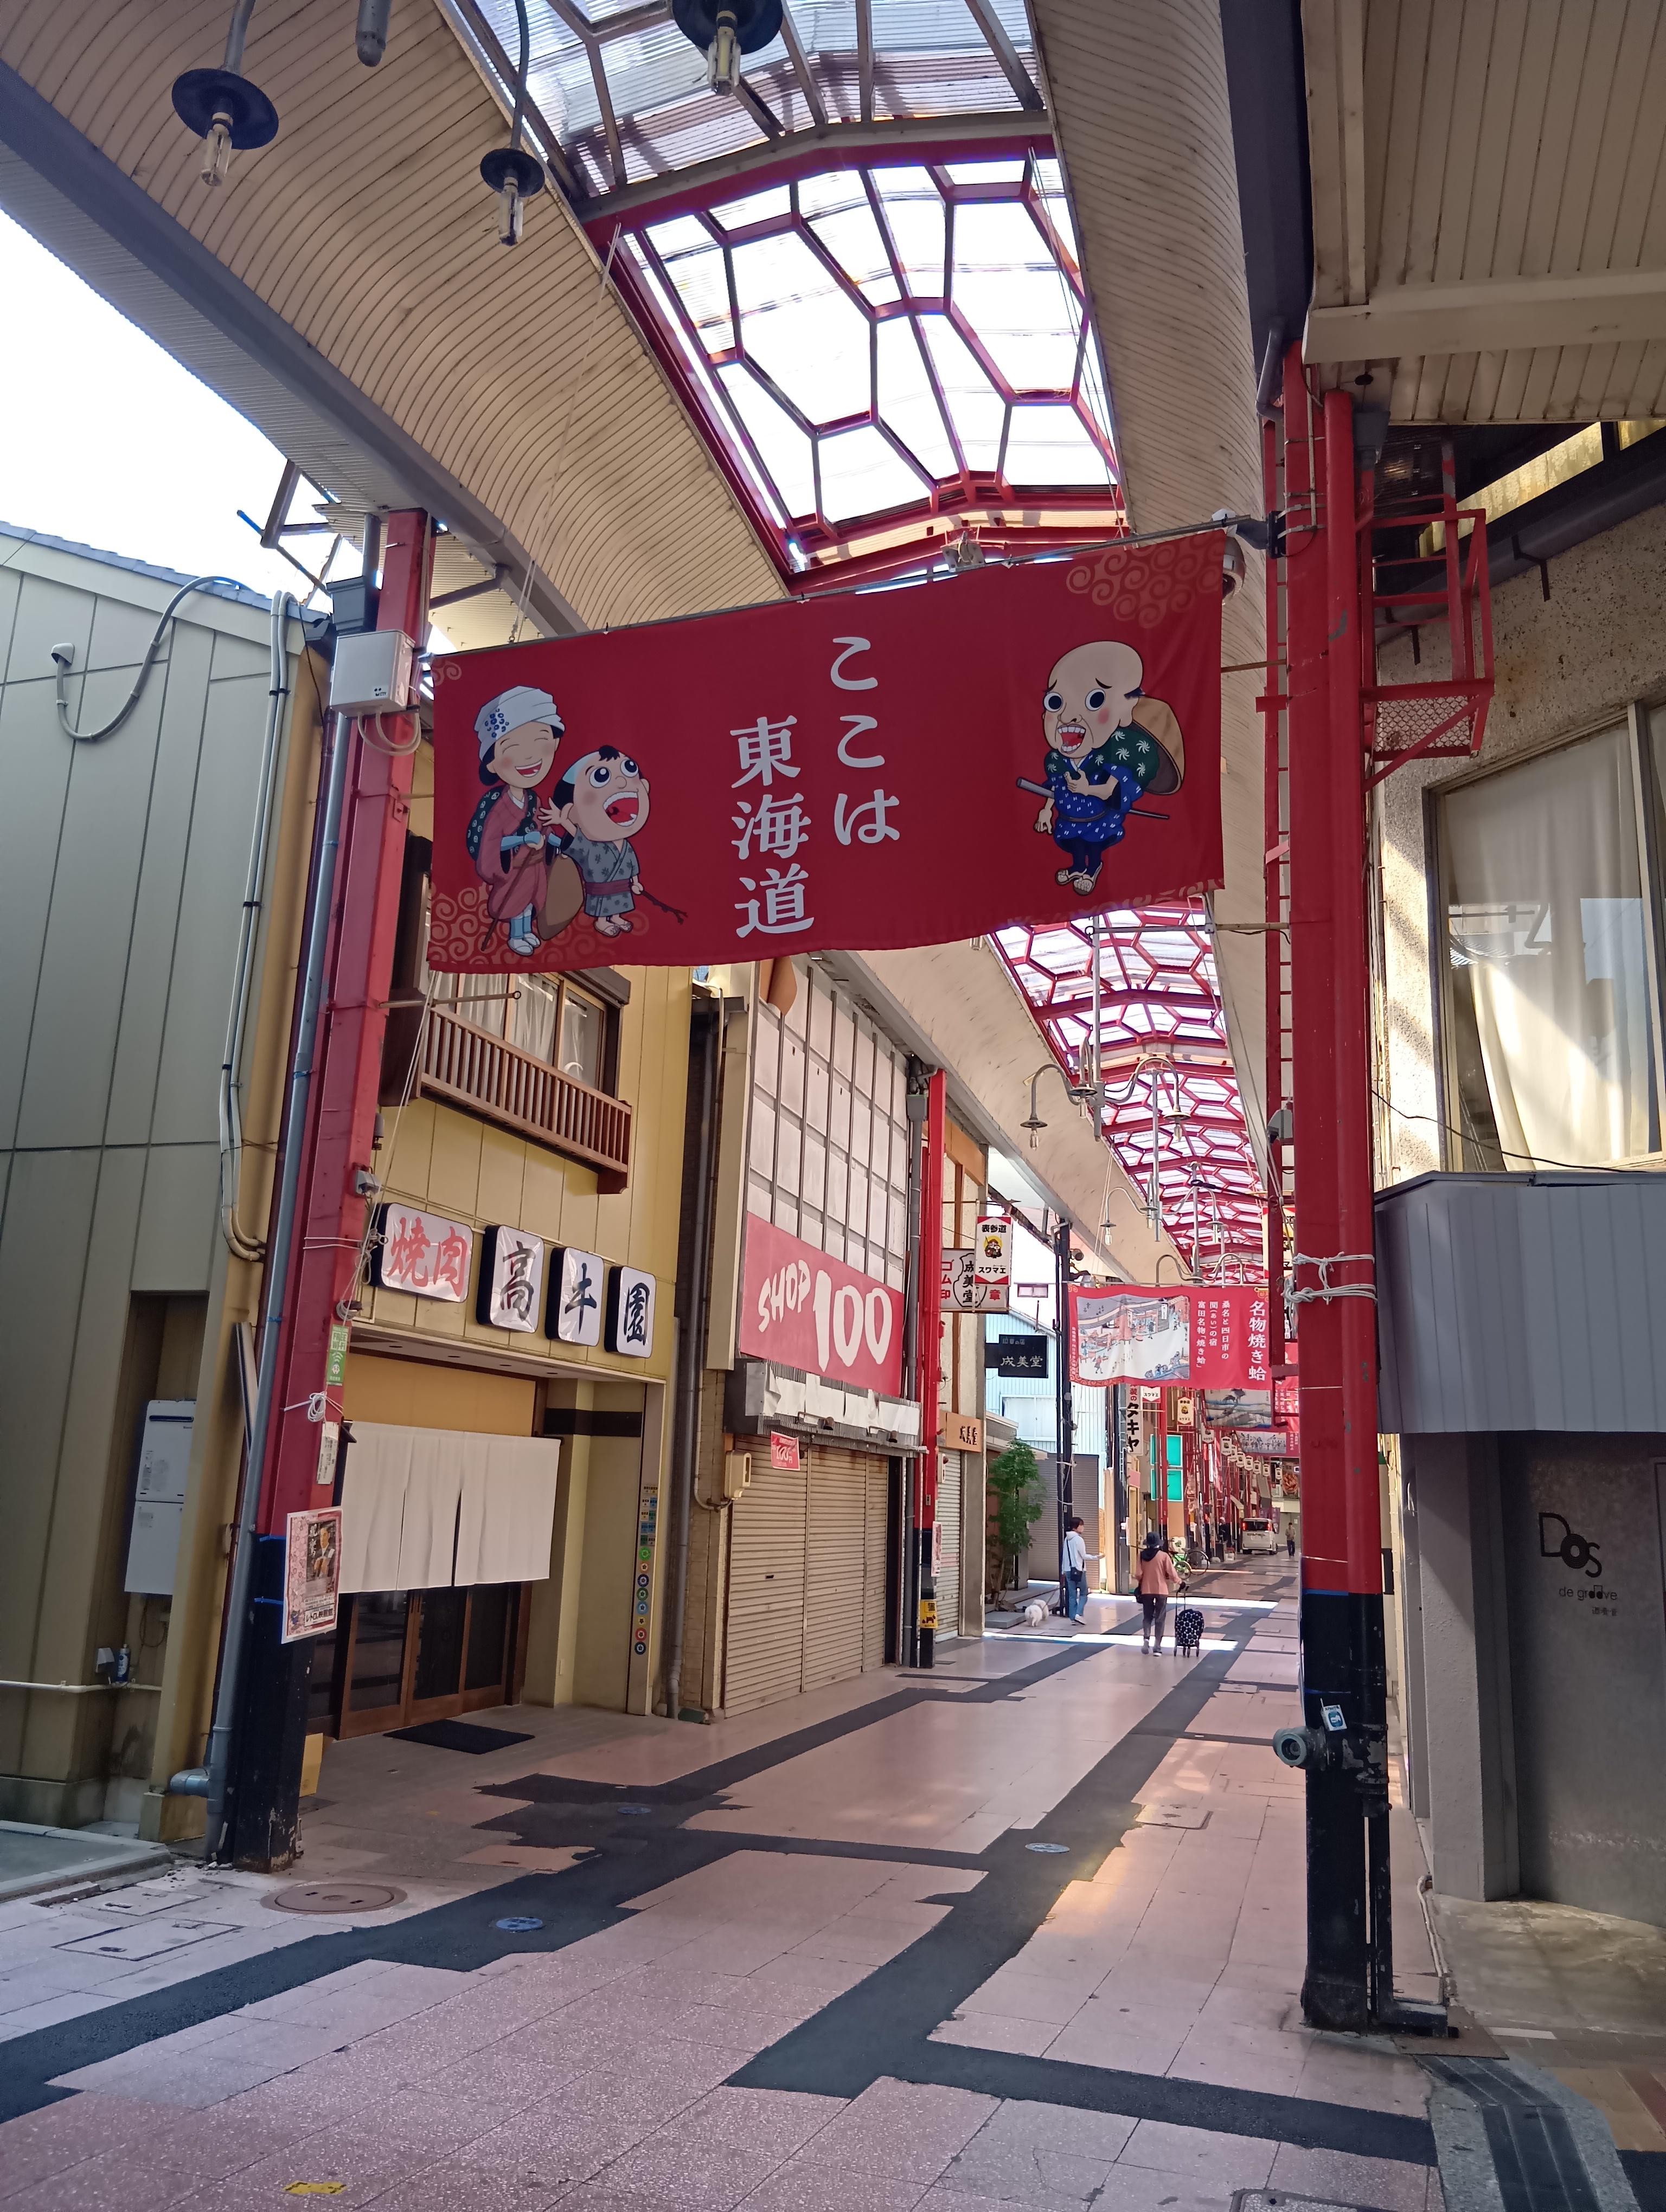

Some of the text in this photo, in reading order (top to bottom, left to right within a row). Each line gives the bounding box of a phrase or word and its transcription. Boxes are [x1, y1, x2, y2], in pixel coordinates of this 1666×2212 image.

[830, 636, 900, 846] ここは
[729, 714, 815, 938] 東海道
[386, 1216, 468, 1297] 焼肉
[982, 1224, 1007, 1233] 表参道
[978, 1266, 1007, 1274] スワマエ
[758, 1259, 893, 1373] SHOP 100
[1221, 1300, 1231, 1360] 桑名と四日市の
[1247, 1300, 1267, 1381] 名物焼き蛤
[1000, 1355, 1043, 1367] 成美堂
[1127, 1402, 1139, 1453] タキヤ
[1558, 1586, 1574, 1597] de
